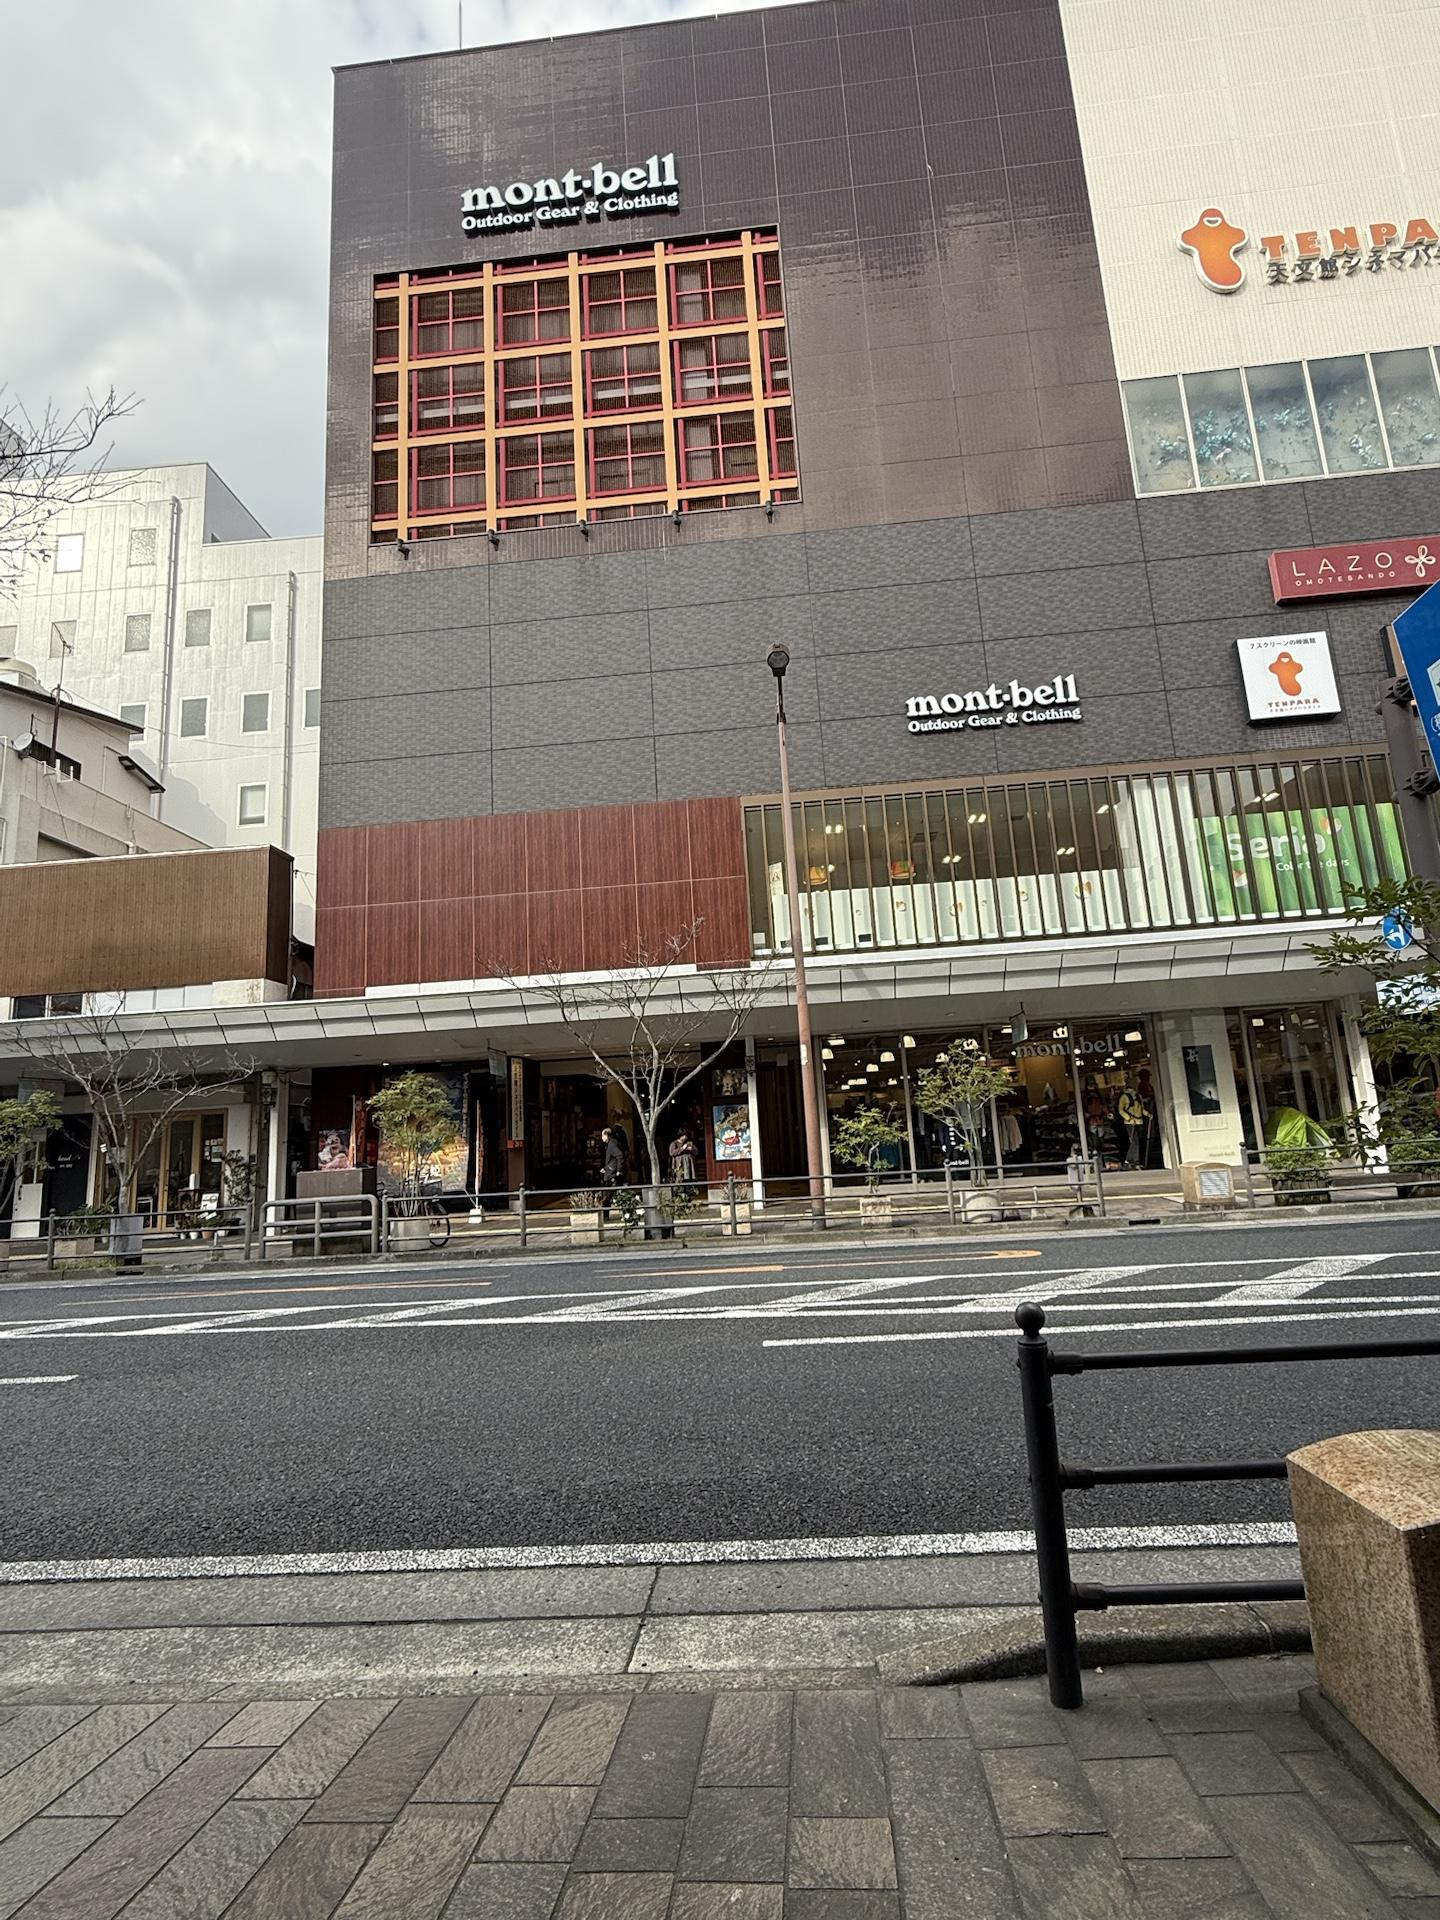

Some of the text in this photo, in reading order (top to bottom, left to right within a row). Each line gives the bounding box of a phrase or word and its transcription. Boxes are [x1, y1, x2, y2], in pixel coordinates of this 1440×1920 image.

[461, 192, 679, 230] Outdoor Gear & Clothing
[1292, 552, 1393, 577] LAZO
[1295, 570, 1396, 587] OMOTESANDO
[1267, 698, 1320, 708] TENPARA
[908, 707, 1082, 733] Outdoor Gear & Clothing
